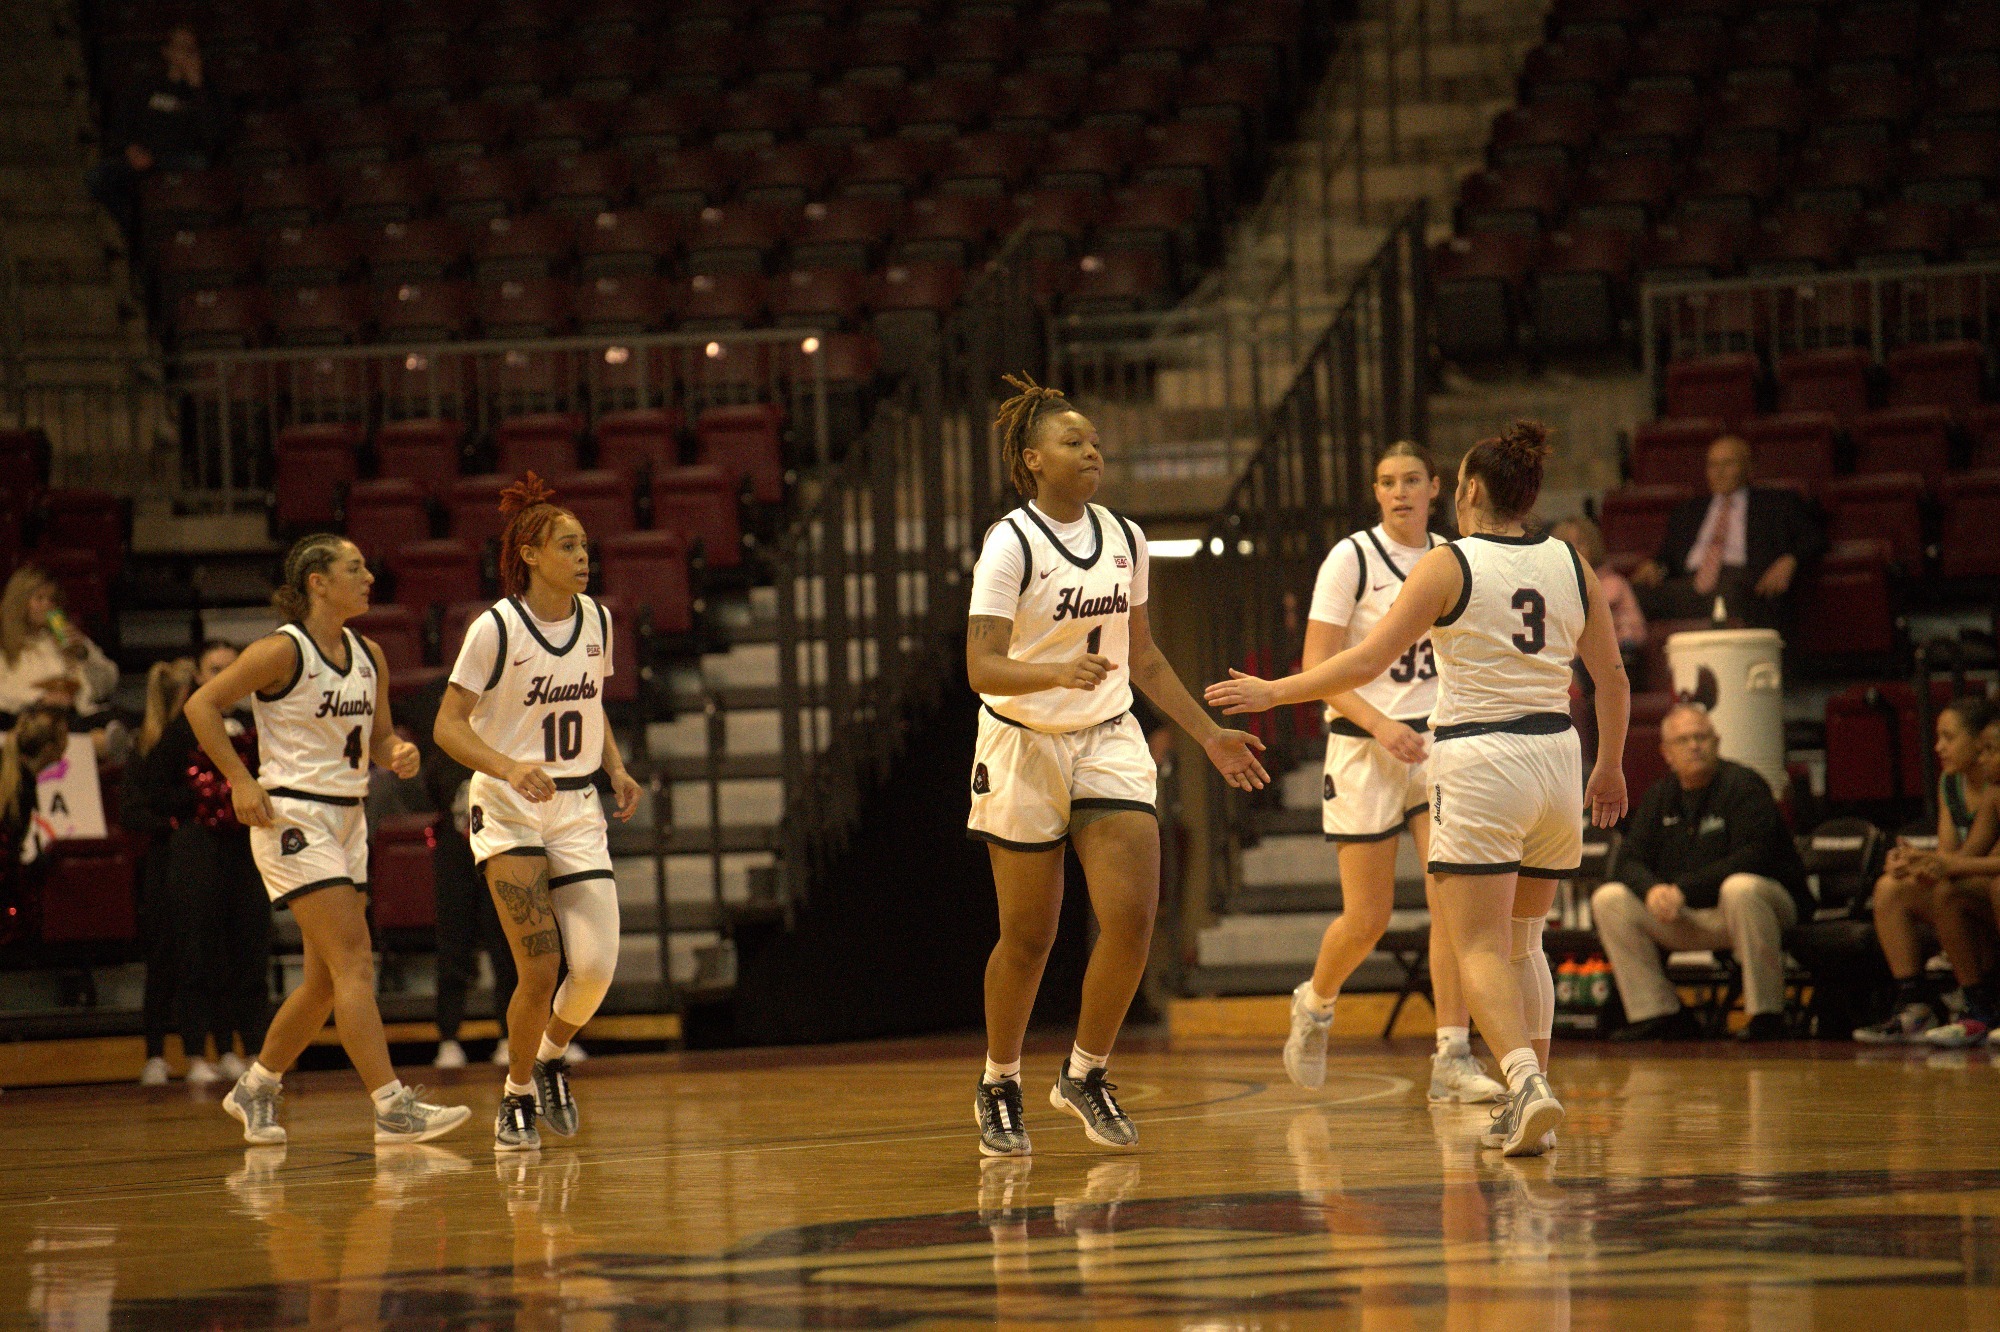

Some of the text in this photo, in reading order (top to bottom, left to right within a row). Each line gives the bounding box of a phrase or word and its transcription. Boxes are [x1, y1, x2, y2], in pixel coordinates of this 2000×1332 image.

[1053, 583, 1128, 621] Hawks
[1511, 588, 1546, 655] 3
[1087, 624, 1102, 655] 1
[1390, 638, 1438, 682] 33
[523, 671, 598, 706] Hawks
[343, 725, 362, 769] 4
[541, 710, 582, 762] 10
